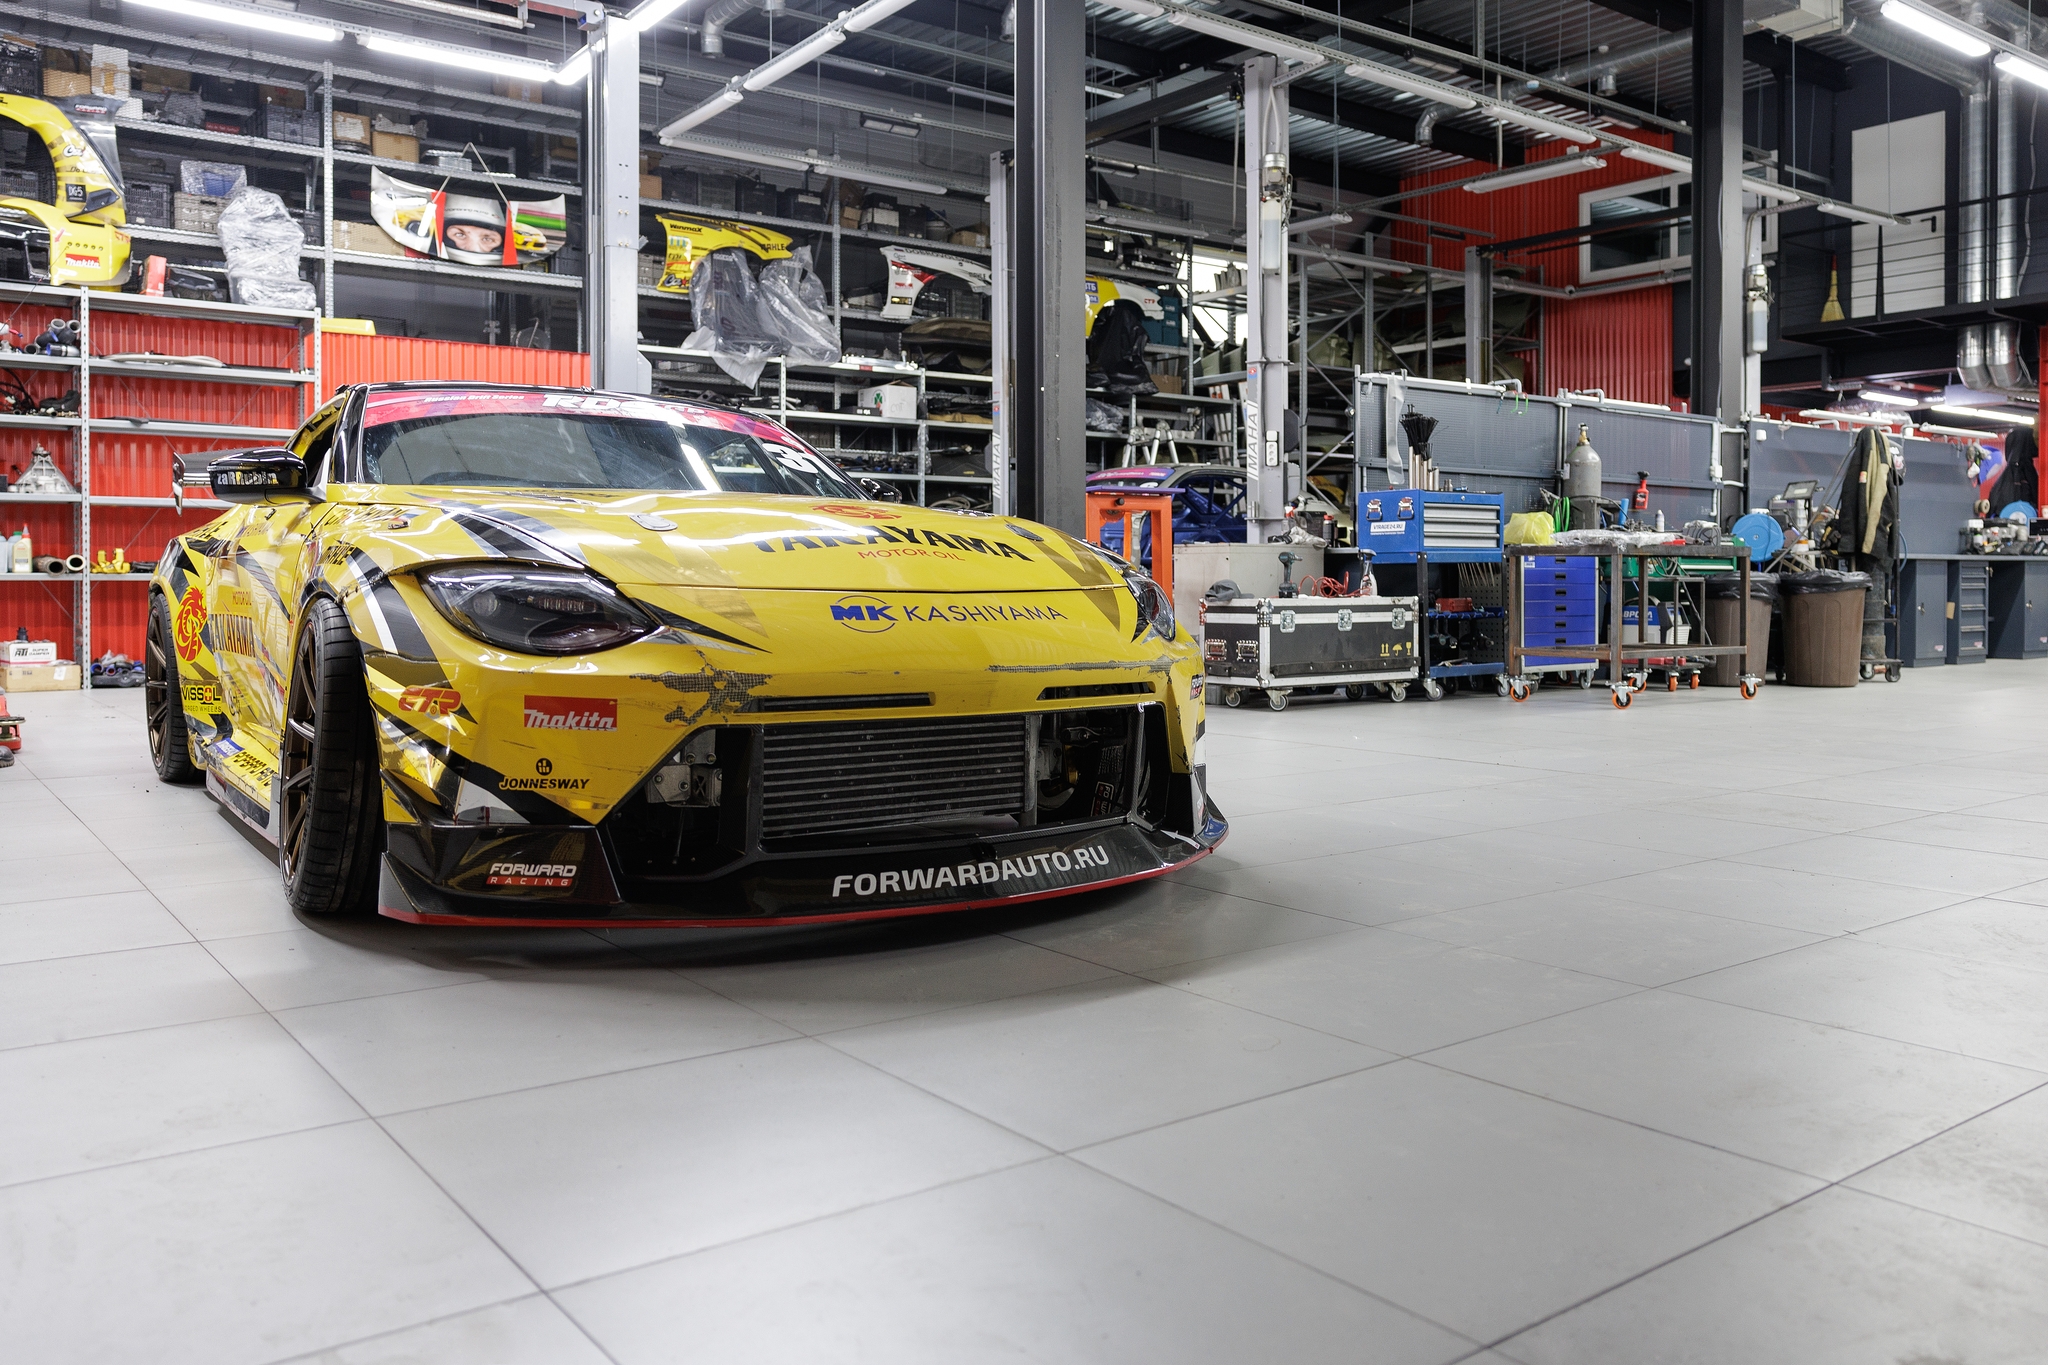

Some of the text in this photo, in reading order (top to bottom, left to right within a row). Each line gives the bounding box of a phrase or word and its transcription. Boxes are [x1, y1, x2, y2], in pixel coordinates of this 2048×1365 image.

[424, 394, 466, 403] Russian
[468, 394, 491, 402] Drift
[1248, 413, 1258, 471] MAHA
[992, 442, 1001, 491] MAHA
[857, 548, 966, 562] MOTOR OIL
[829, 602, 1069, 623] MK KASHIYAMA
[524, 709, 618, 732] Makita
[499, 777, 590, 790] JONNESWAY
[489, 862, 578, 877] FORWARD
[832, 845, 1110, 898] FORWARDAUTO.RU
[489, 877, 569, 886] RACING
